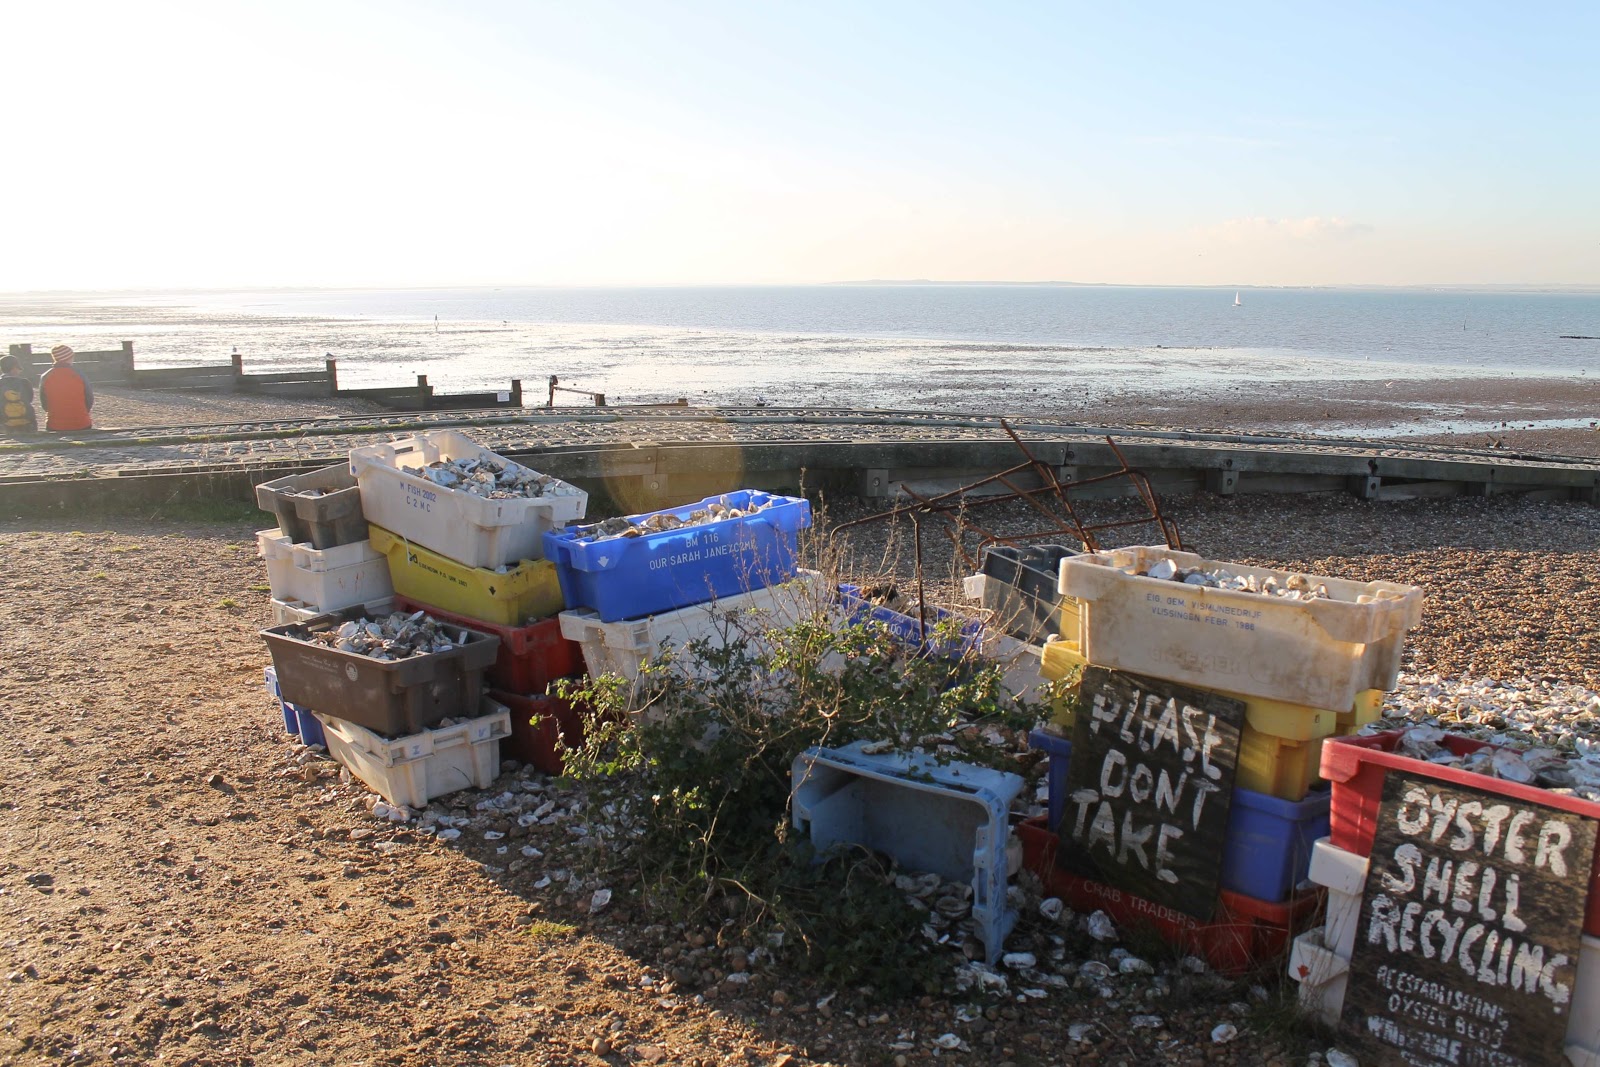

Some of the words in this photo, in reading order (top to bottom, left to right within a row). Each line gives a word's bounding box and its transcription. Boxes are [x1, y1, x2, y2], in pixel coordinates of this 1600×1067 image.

[407, 484, 421, 496] FISH
[649, 557, 668, 571] OUR
[670, 550, 701, 567] SARAH
[685, 537, 699, 548] BM
[703, 532, 719, 545] 116
[1151, 607, 1201, 623] VLISSINGEN
[1089, 689, 1222, 780] PLEASE
[1100, 748, 1221, 831] DON'T
[1070, 788, 1185, 884] TAKE
[1397, 786, 1573, 878] OYSTER
[1083, 880, 1121, 903] CRAB
[1130, 895, 1197, 930] TRADERS
[1378, 842, 1528, 933] SHELL
[1367, 892, 1570, 1015] RECYCLING
